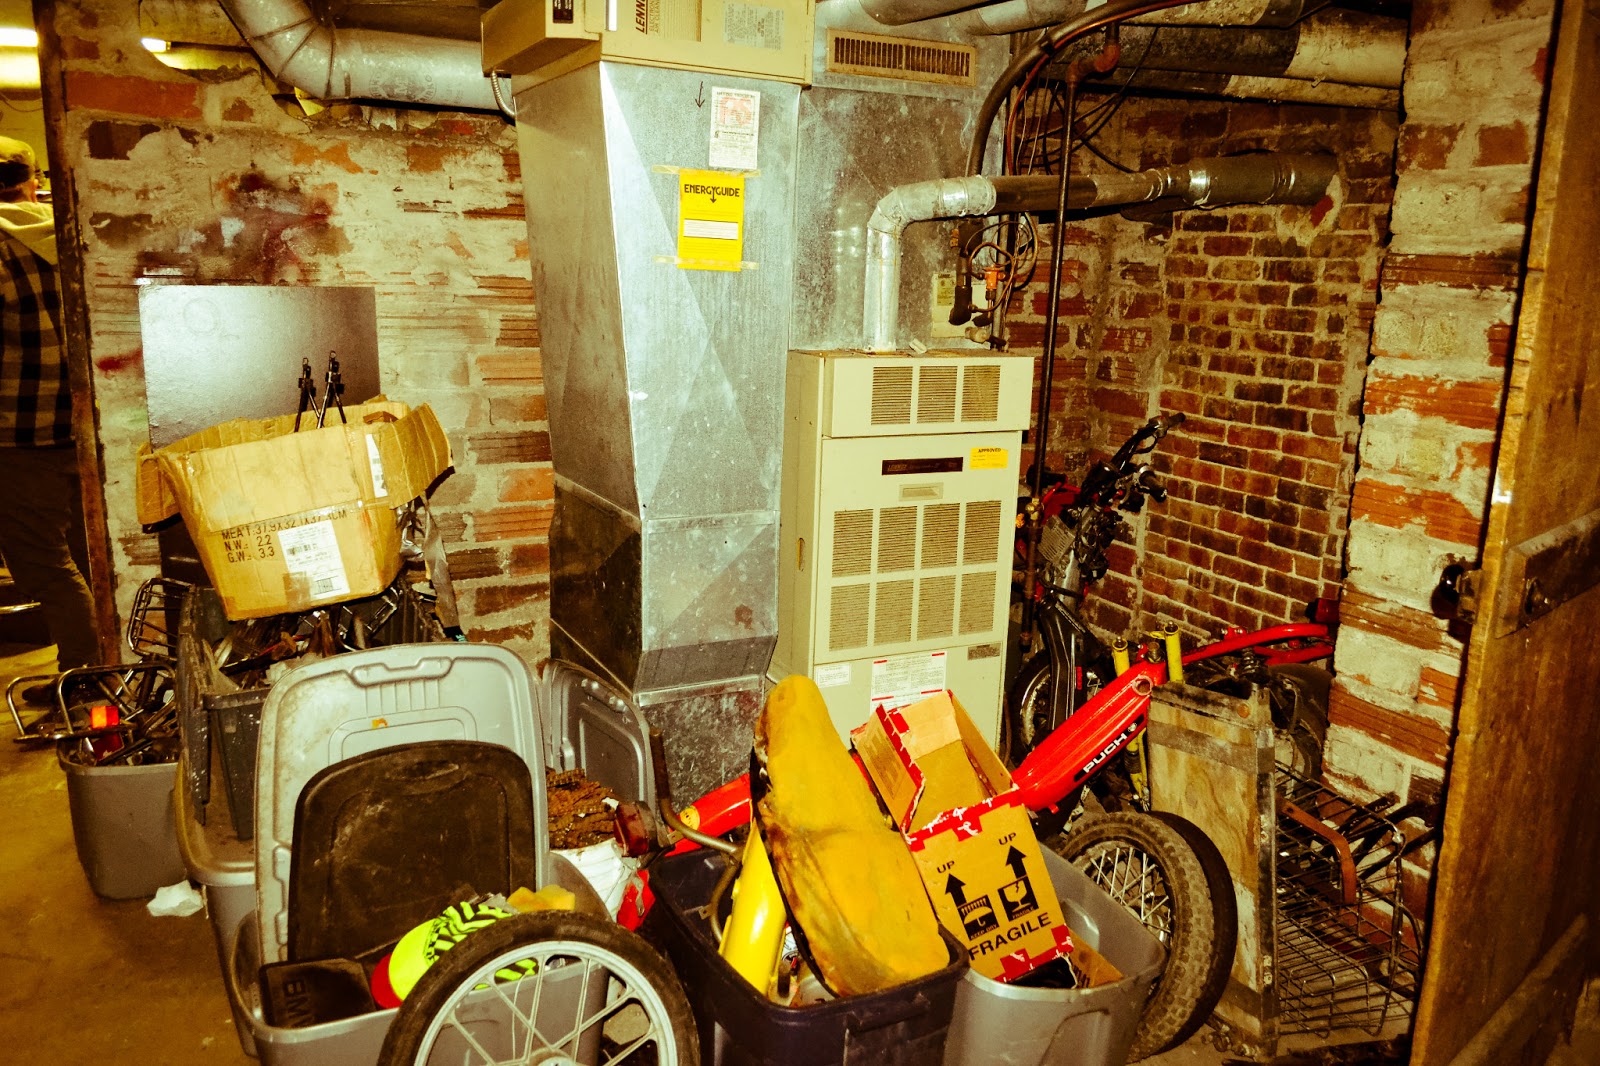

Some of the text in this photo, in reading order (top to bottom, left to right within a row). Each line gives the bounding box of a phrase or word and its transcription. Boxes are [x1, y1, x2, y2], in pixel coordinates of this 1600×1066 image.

[635, 0, 645, 33] LENN
[684, 184, 740, 199] ENERGYGUIDE
[256, 534, 272, 547] 2.2
[259, 546, 275, 559] 3.3
[1083, 733, 1127, 773] PUCH
[998, 832, 1017, 846] UP
[936, 860, 956, 874] UP
[968, 912, 1052, 961] FRAGILE
